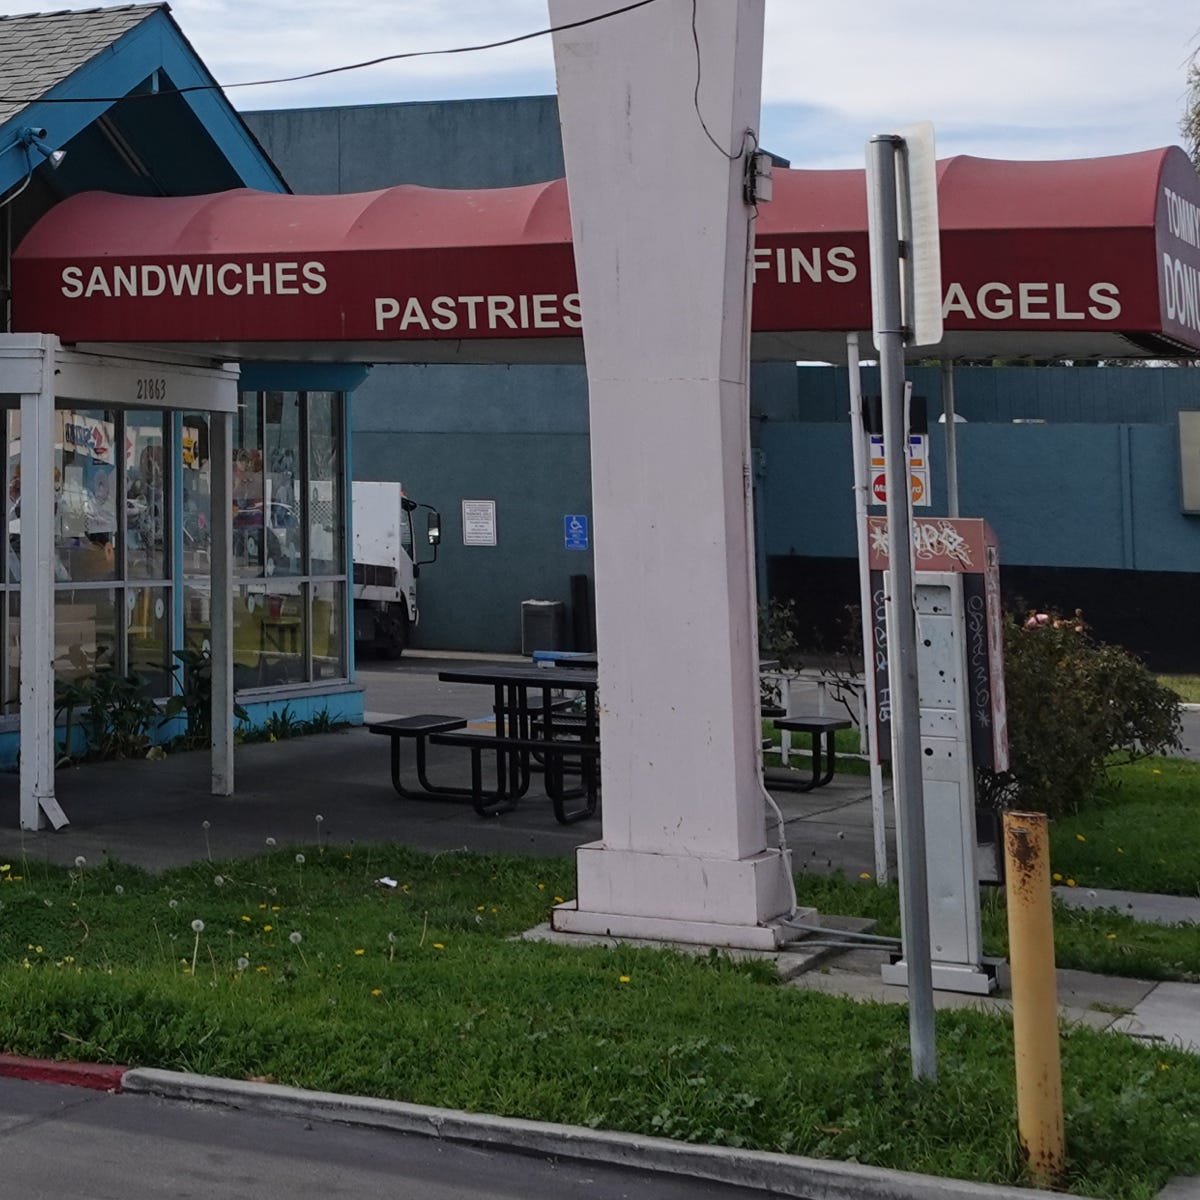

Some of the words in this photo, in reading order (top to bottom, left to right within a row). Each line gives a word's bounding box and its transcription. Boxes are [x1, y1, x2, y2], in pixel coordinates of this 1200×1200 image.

[1164, 187, 1200, 249] TOMMY
[61, 260, 327, 298] SANDWICHES
[752, 246, 857, 283] FINS
[942, 282, 1121, 320] AGELS
[1163, 252, 1200, 333] DONU
[375, 293, 583, 331] PASTRIES
[137, 379, 166, 400] 21863
